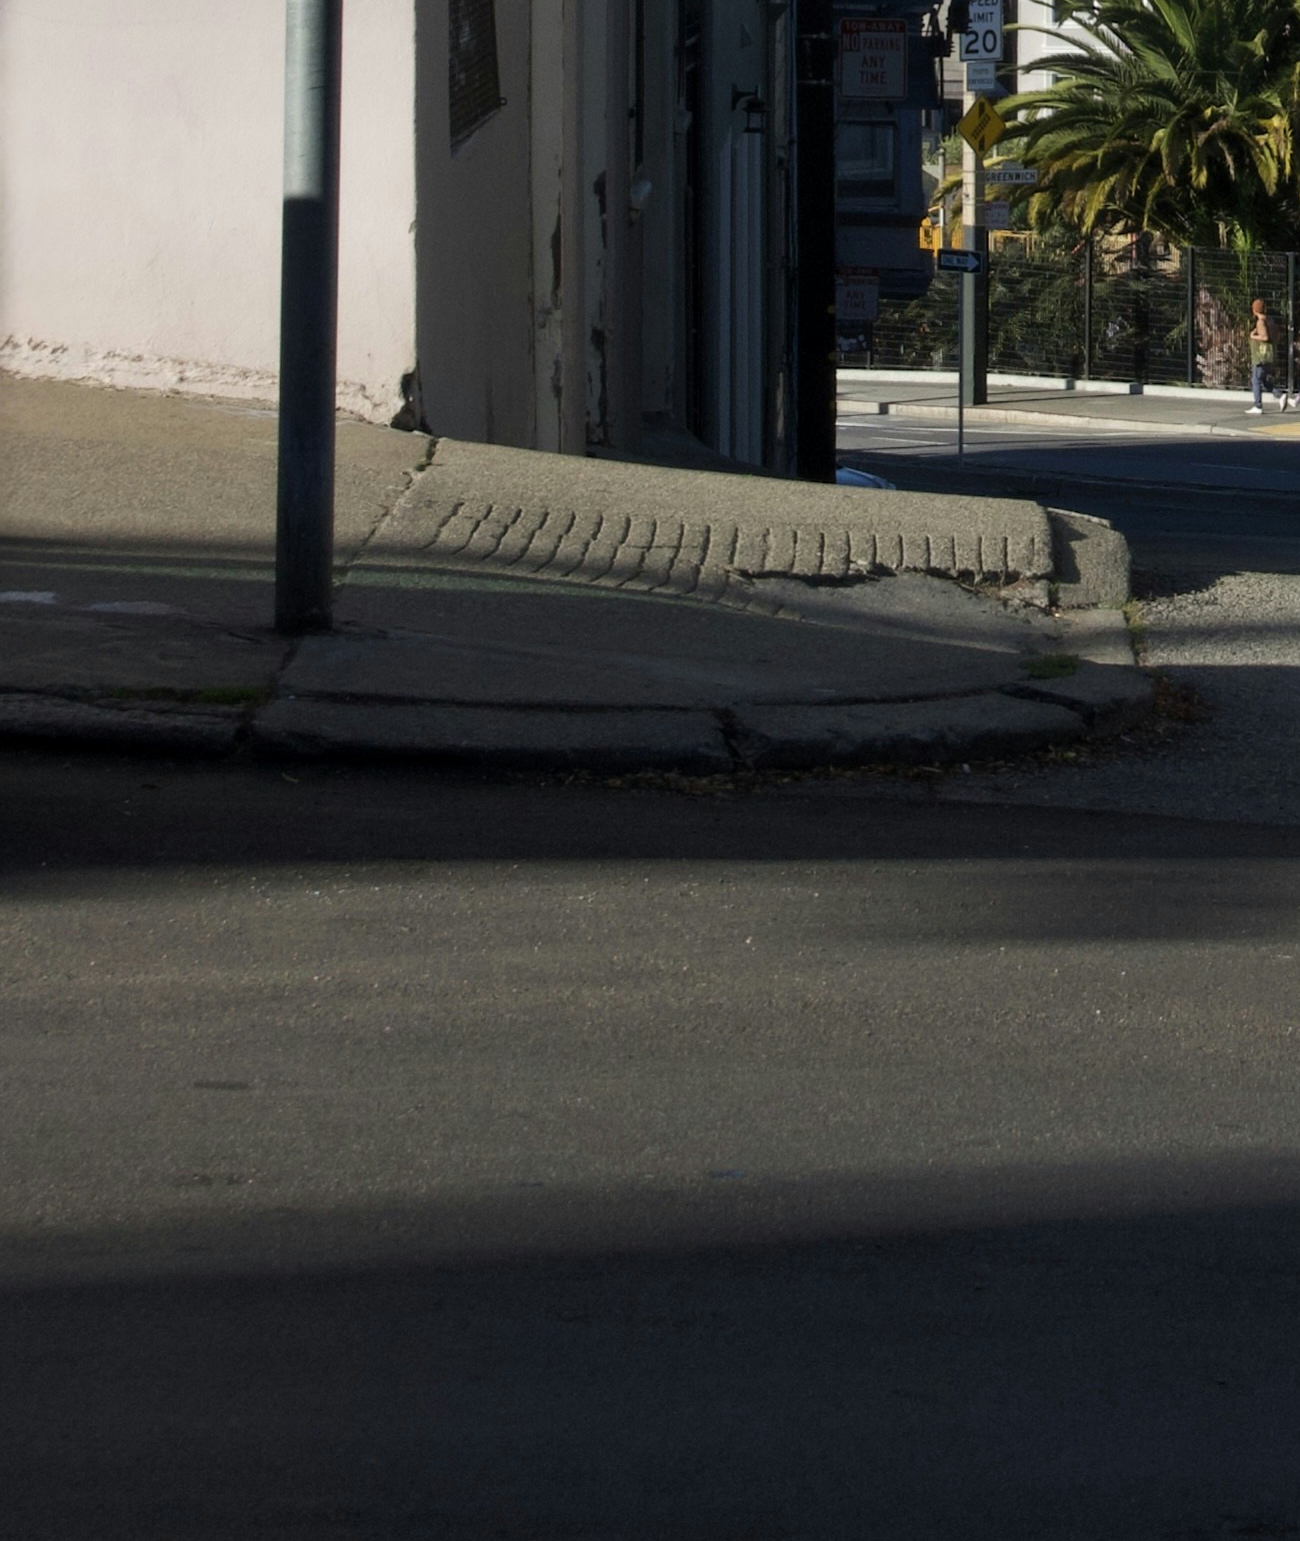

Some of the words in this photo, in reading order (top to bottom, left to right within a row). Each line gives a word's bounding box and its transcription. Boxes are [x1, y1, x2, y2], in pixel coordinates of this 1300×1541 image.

[973, 12, 994, 23] IMIT
[843, 33, 859, 50] NO
[965, 29, 997, 54] 20
[861, 54, 886, 68] ANY
[859, 70, 887, 85] TIME
[985, 171, 1036, 182] GREENWICH
